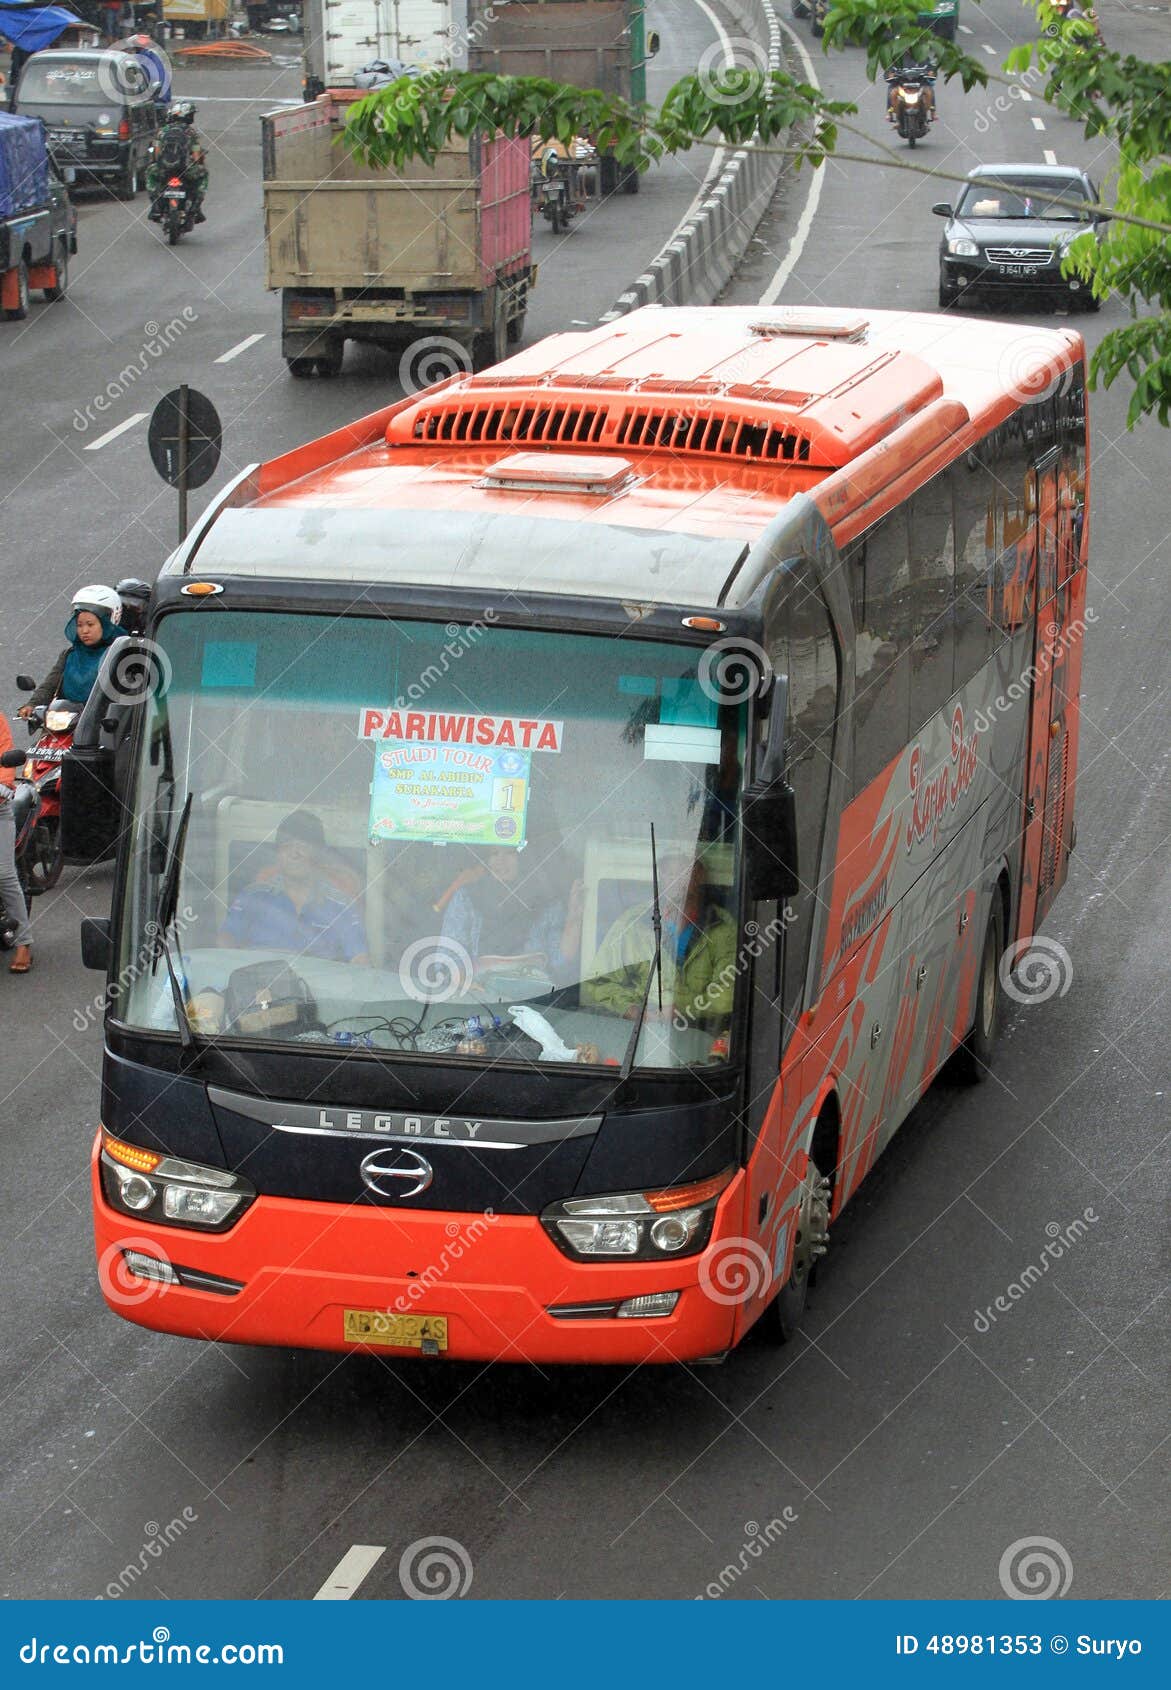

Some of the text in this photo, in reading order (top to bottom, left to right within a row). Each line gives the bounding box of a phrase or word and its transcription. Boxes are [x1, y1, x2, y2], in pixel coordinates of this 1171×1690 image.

[363, 710, 559, 751] PARIWISATA
[381, 747, 495, 774] STUDI TOUR
[388, 768, 415, 780] SMP
[420, 770, 437, 782] AL
[394, 783, 475, 799] SURAKARTA
[501, 783, 514, 811] 1
[318, 1109, 484, 1139] LEGACY
